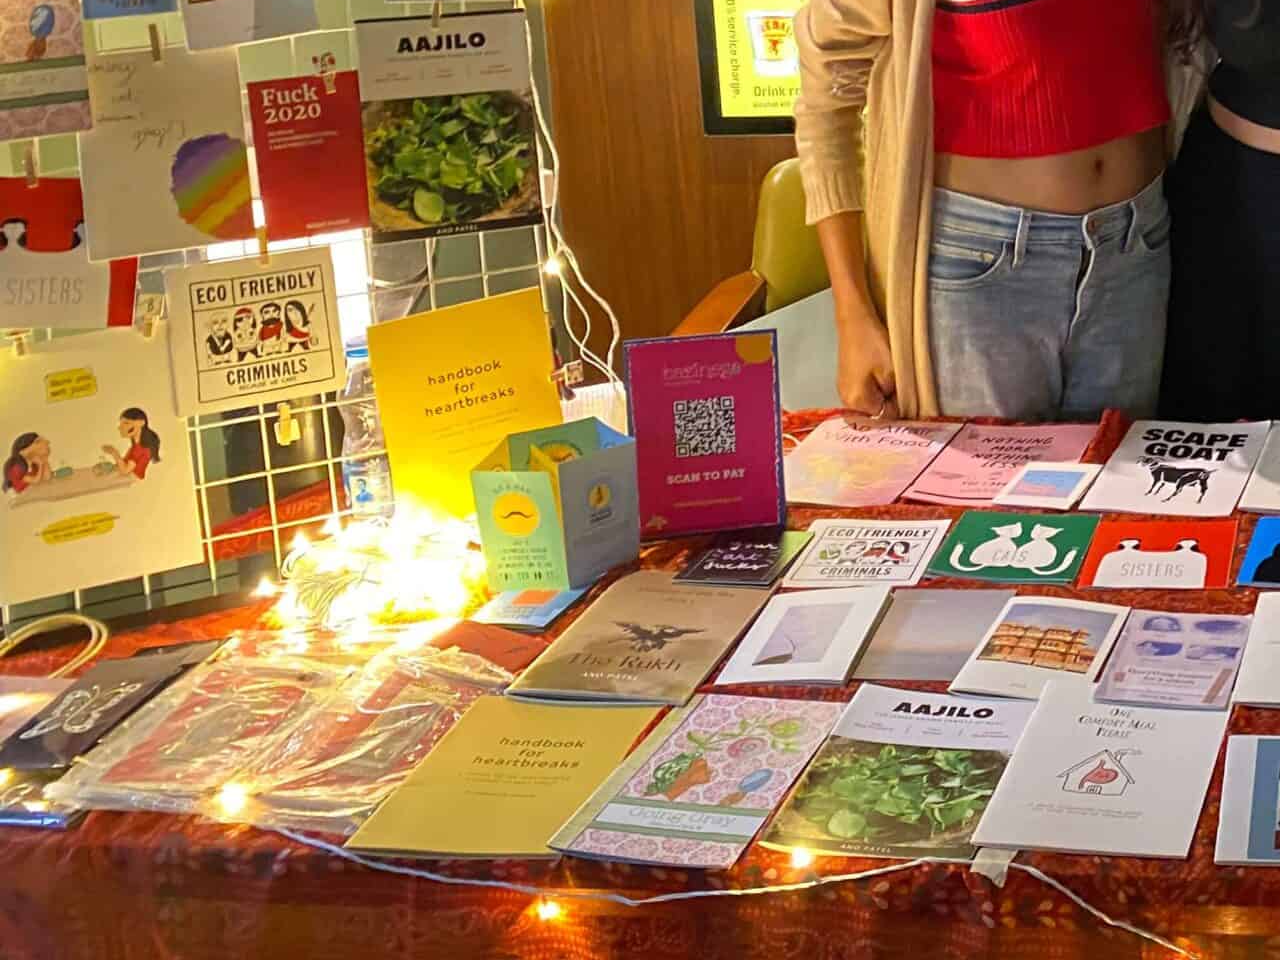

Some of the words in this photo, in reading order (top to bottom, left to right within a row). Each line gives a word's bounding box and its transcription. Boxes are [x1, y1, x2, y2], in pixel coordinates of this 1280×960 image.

[397, 32, 487, 54] AAJILO
[261, 83, 320, 107] Fuck
[753, 86, 784, 97] Drink
[264, 102, 321, 125] 2020
[4, 278, 84, 306] SISTERS
[196, 284, 227, 305] ECO
[240, 271, 316, 298] FRIENDLY
[226, 358, 308, 386] CRIMINALS
[427, 359, 502, 385] handbook
[454, 382, 475, 395] for
[424, 387, 515, 417] heartbreaks
[877, 437, 931, 448] Food
[981, 436, 1054, 445] NOTHING
[1141, 428, 1249, 448] SCAPE
[971, 453, 1042, 461] NOTHING
[990, 445, 1032, 453] MORE
[1144, 443, 1234, 462] GOAT
[666, 472, 701, 485] SCAN
[703, 470, 721, 481] TO
[723, 468, 746, 479] PAY
[827, 527, 856, 538] ECO
[861, 528, 932, 538] FRIENDLY
[992, 549, 1029, 563] CATS
[819, 565, 893, 577] CRIMINALS
[1120, 562, 1185, 578] SISTERS
[893, 701, 994, 719] AAJILO
[499, 737, 585, 748] handbook
[518, 748, 544, 757] for
[472, 756, 580, 769] heartbreaks
